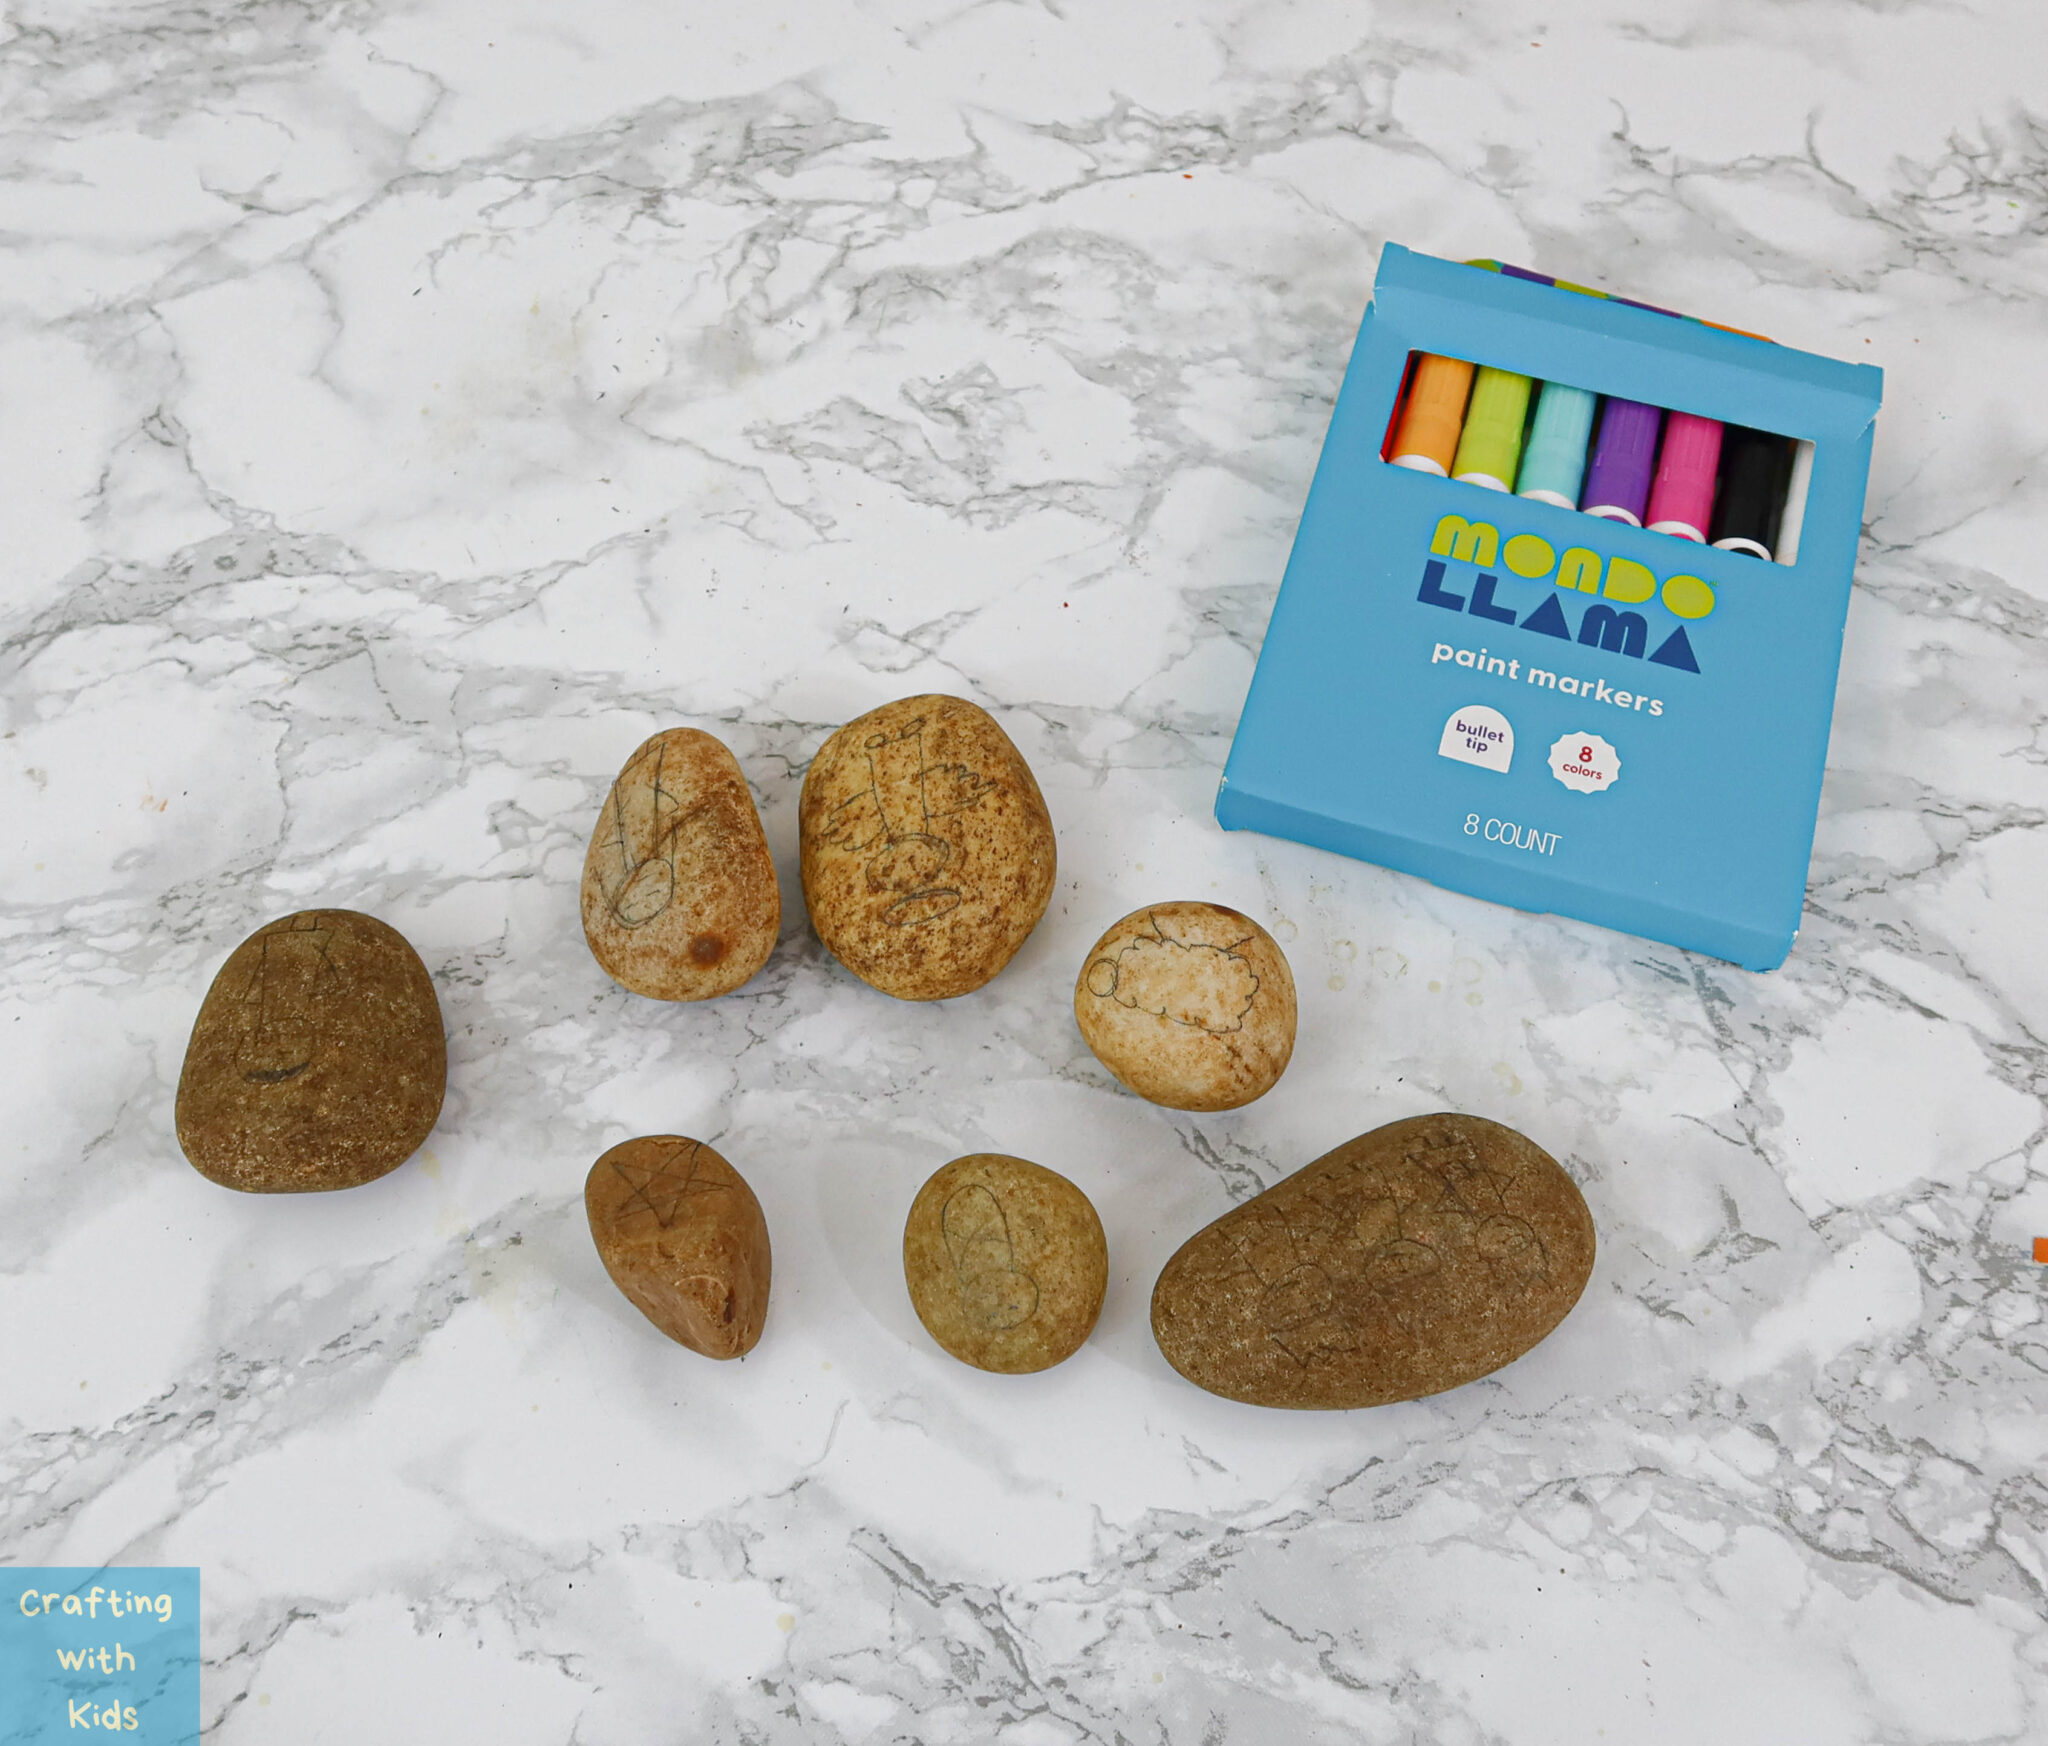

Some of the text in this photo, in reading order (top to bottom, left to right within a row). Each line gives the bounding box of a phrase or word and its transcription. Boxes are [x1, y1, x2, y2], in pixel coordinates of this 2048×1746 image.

[1431, 641, 1665, 717] paint markers
[1455, 719, 1505, 743] bullet
[1466, 736, 1488, 753] tip
[1579, 746, 1593, 763] 8
[1562, 762, 1603, 780] colors
[1463, 812, 1563, 856] 8 COUNT
